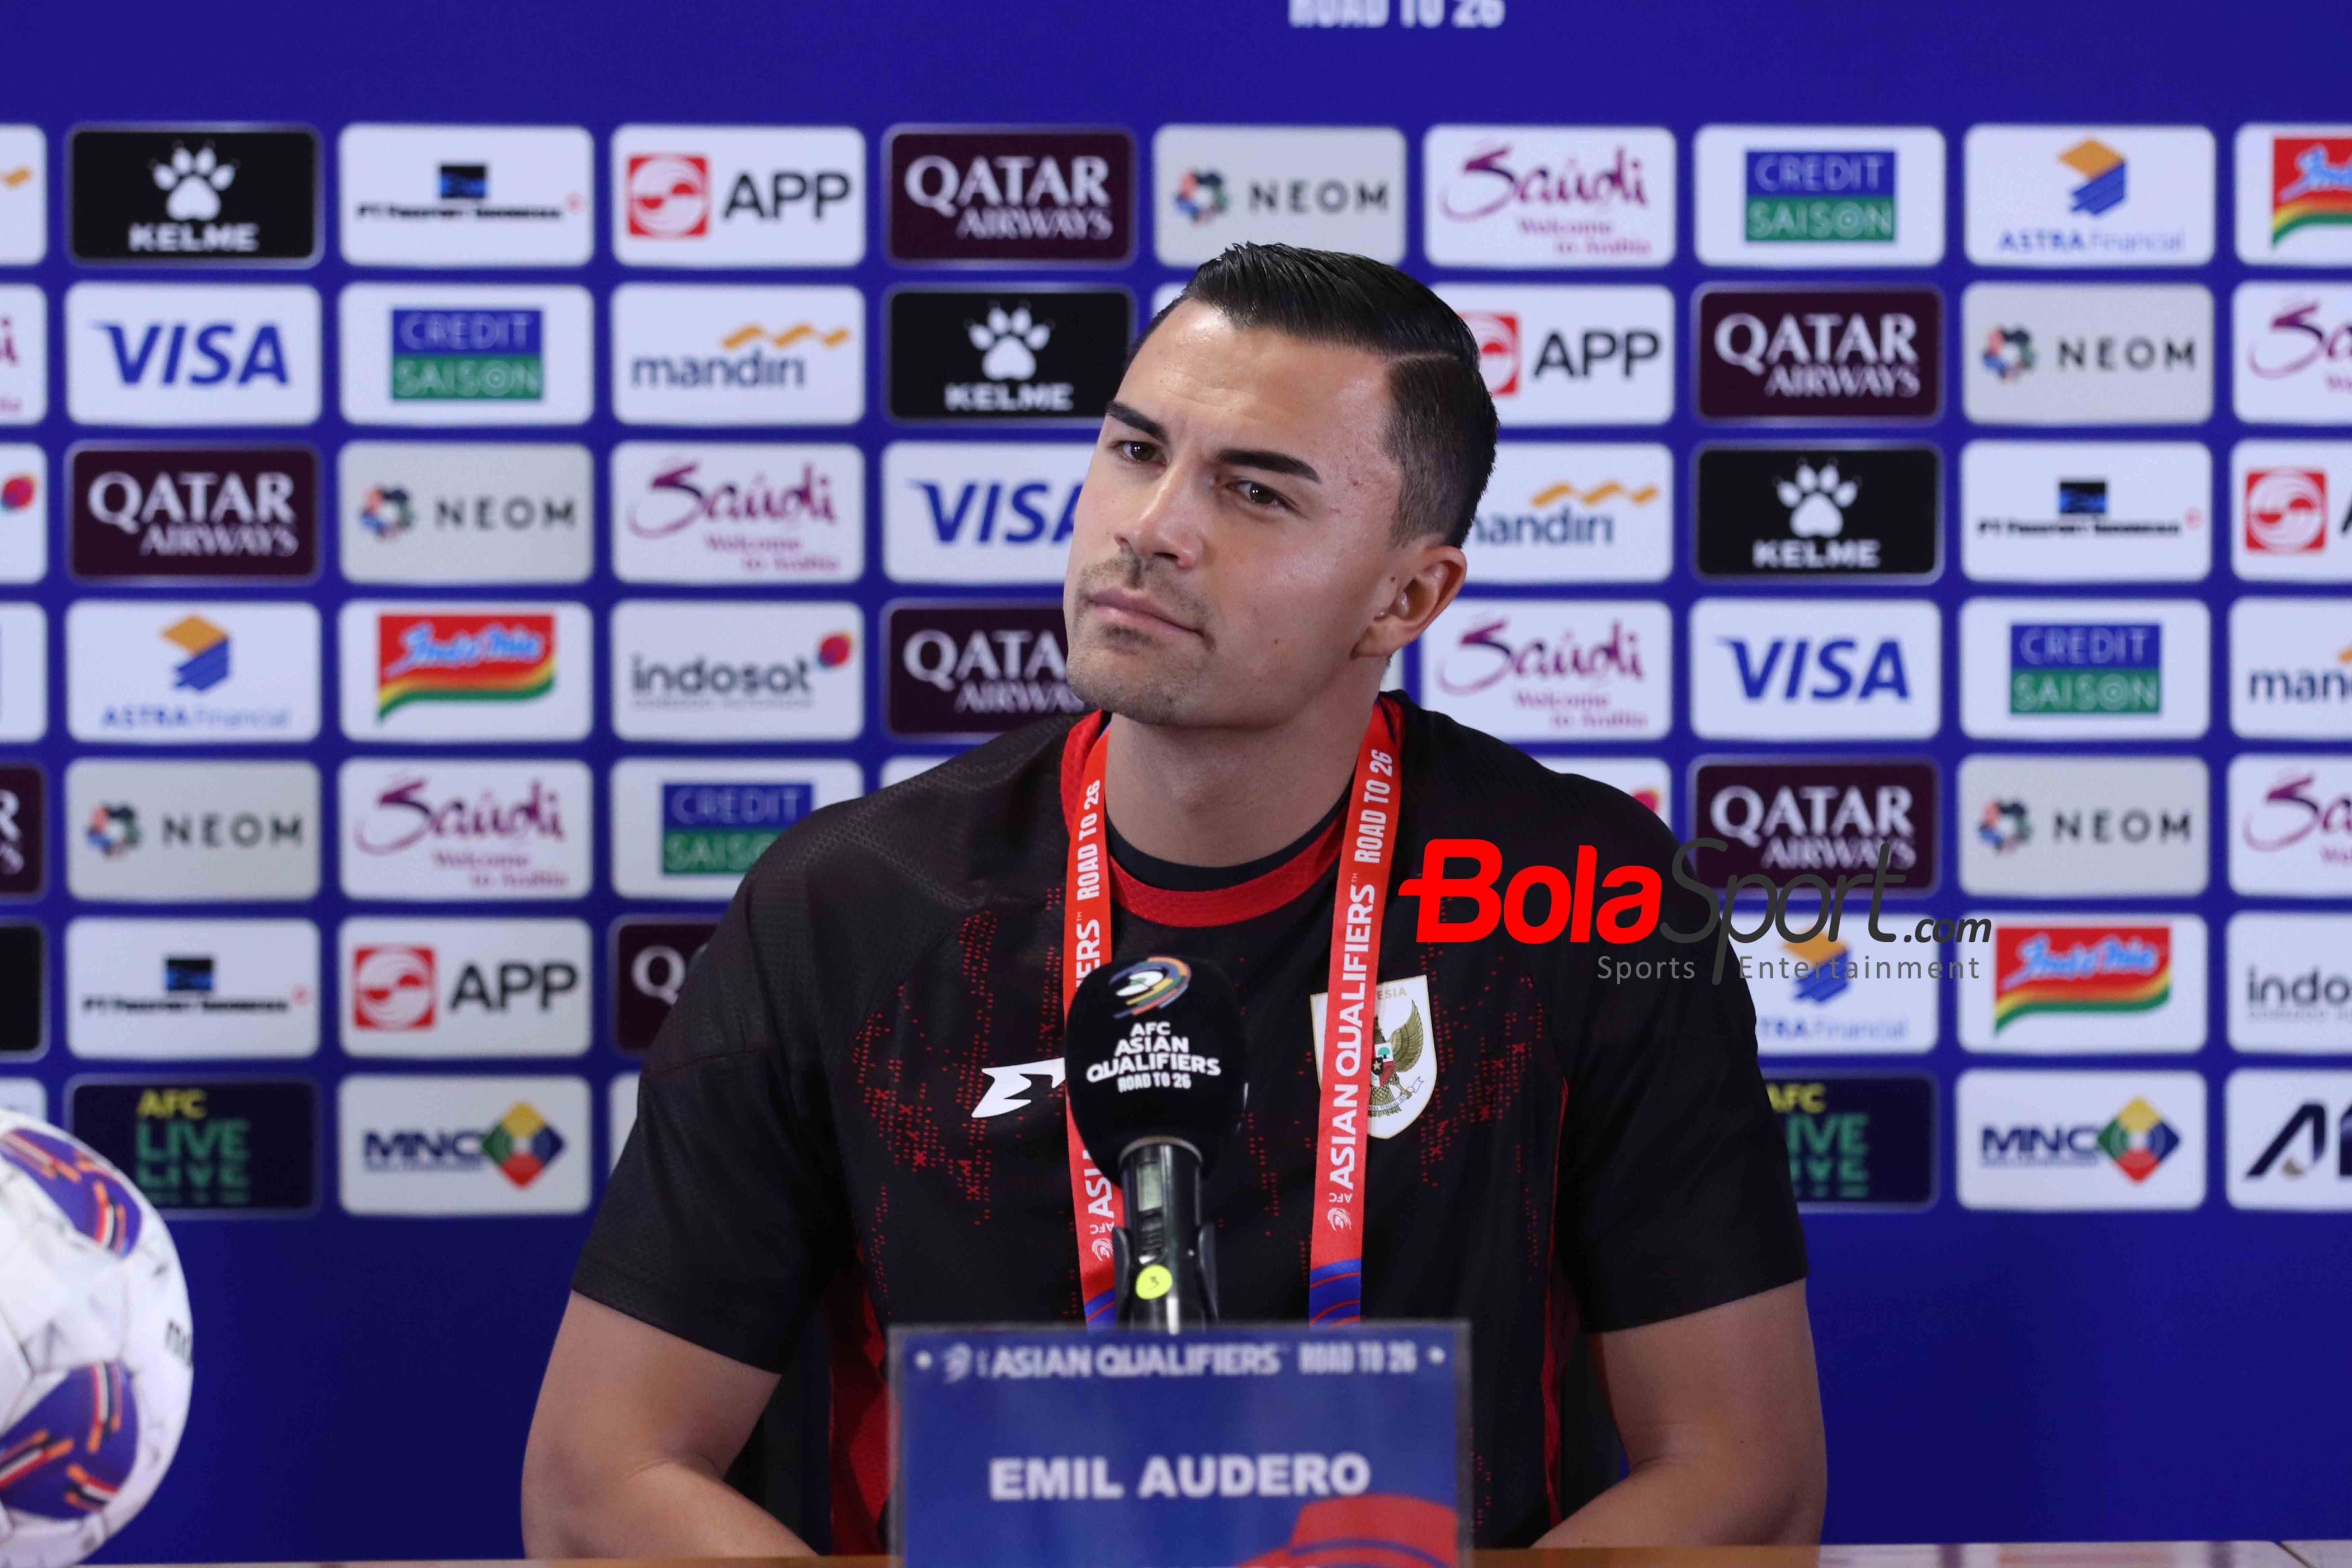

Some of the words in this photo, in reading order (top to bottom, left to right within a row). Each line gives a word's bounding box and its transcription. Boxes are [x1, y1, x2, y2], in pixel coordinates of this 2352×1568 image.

[904, 155, 1110, 218] QATAR
[1755, 155, 1884, 191] CREDIT
[724, 171, 851, 220] APP
[1248, 180, 1389, 211] NEOM
[127, 223, 259, 252] KELME
[956, 206, 1112, 240] AIRWAYS
[1748, 202, 1893, 240] SAISON
[1999, 231, 2083, 252] ASTRA
[400, 313, 532, 349] CREDIT
[1713, 311, 1919, 376] QATAR
[91, 319, 290, 386] VISA
[1532, 329, 1660, 378] APP
[2058, 338, 2197, 370] NEOM
[394, 358, 541, 395] SAISON
[1764, 364, 1920, 398] AIRWAYS
[945, 382, 1074, 410] KELME
[87, 471, 294, 534] QATAR
[435, 499, 575, 528] NEOM
[140, 523, 298, 556] AIRWAYS
[1751, 538, 1881, 569] KELME
[903, 630, 1068, 692] QATA
[2019, 629, 2149, 665] CREDIT
[631, 653, 813, 694] indosat
[1713, 636, 1910, 701] VISA
[955, 680, 1084, 712] AIRWA
[2012, 673, 2157, 711] SAISON
[102, 706, 186, 728] ASTRA
[1370, 749, 1392, 777] 26
[671, 787, 801, 825] CREDIT
[1084, 779, 1100, 810] 26
[1363, 780, 1391, 807] TO
[162, 815, 304, 846] NEOM
[1078, 813, 1098, 841] TO
[1709, 785, 1914, 847] QATAR
[2053, 810, 2192, 843] NEOM
[665, 833, 777, 870] SAIS
[1354, 809, 1386, 863] ROAD
[1076, 842, 1099, 901] ROAD
[451, 962, 577, 1011] APP
[2247, 965, 2352, 1005] indo
[1130, 1021, 1170, 1037] AFC
[1755, 1016, 1809, 1037] TRA
[1114, 1036, 1189, 1057] ASIAN
[1087, 1052, 1221, 1083] QUALIFIERS
[1117, 1073, 1152, 1093] ROAD
[1153, 1072, 1170, 1087] TO
[1172, 1072, 1192, 1089] 26
[138, 1088, 206, 1118] AFC
[365, 1130, 483, 1158] MNC
[1329, 1084, 1358, 1190] ASIAN
[1786, 1113, 1869, 1153] IVE
[1981, 1126, 2100, 1153] MNC
[1083, 1150, 1114, 1218] ASI
[1329, 1192, 1353, 1203] AFC
[991, 1345, 1092, 1378] ASIAN
[1096, 1343, 1281, 1378] QUALIFIERS
[990, 1458, 1123, 1499] EMIL
[1138, 1454, 1370, 1498] AUDERO
